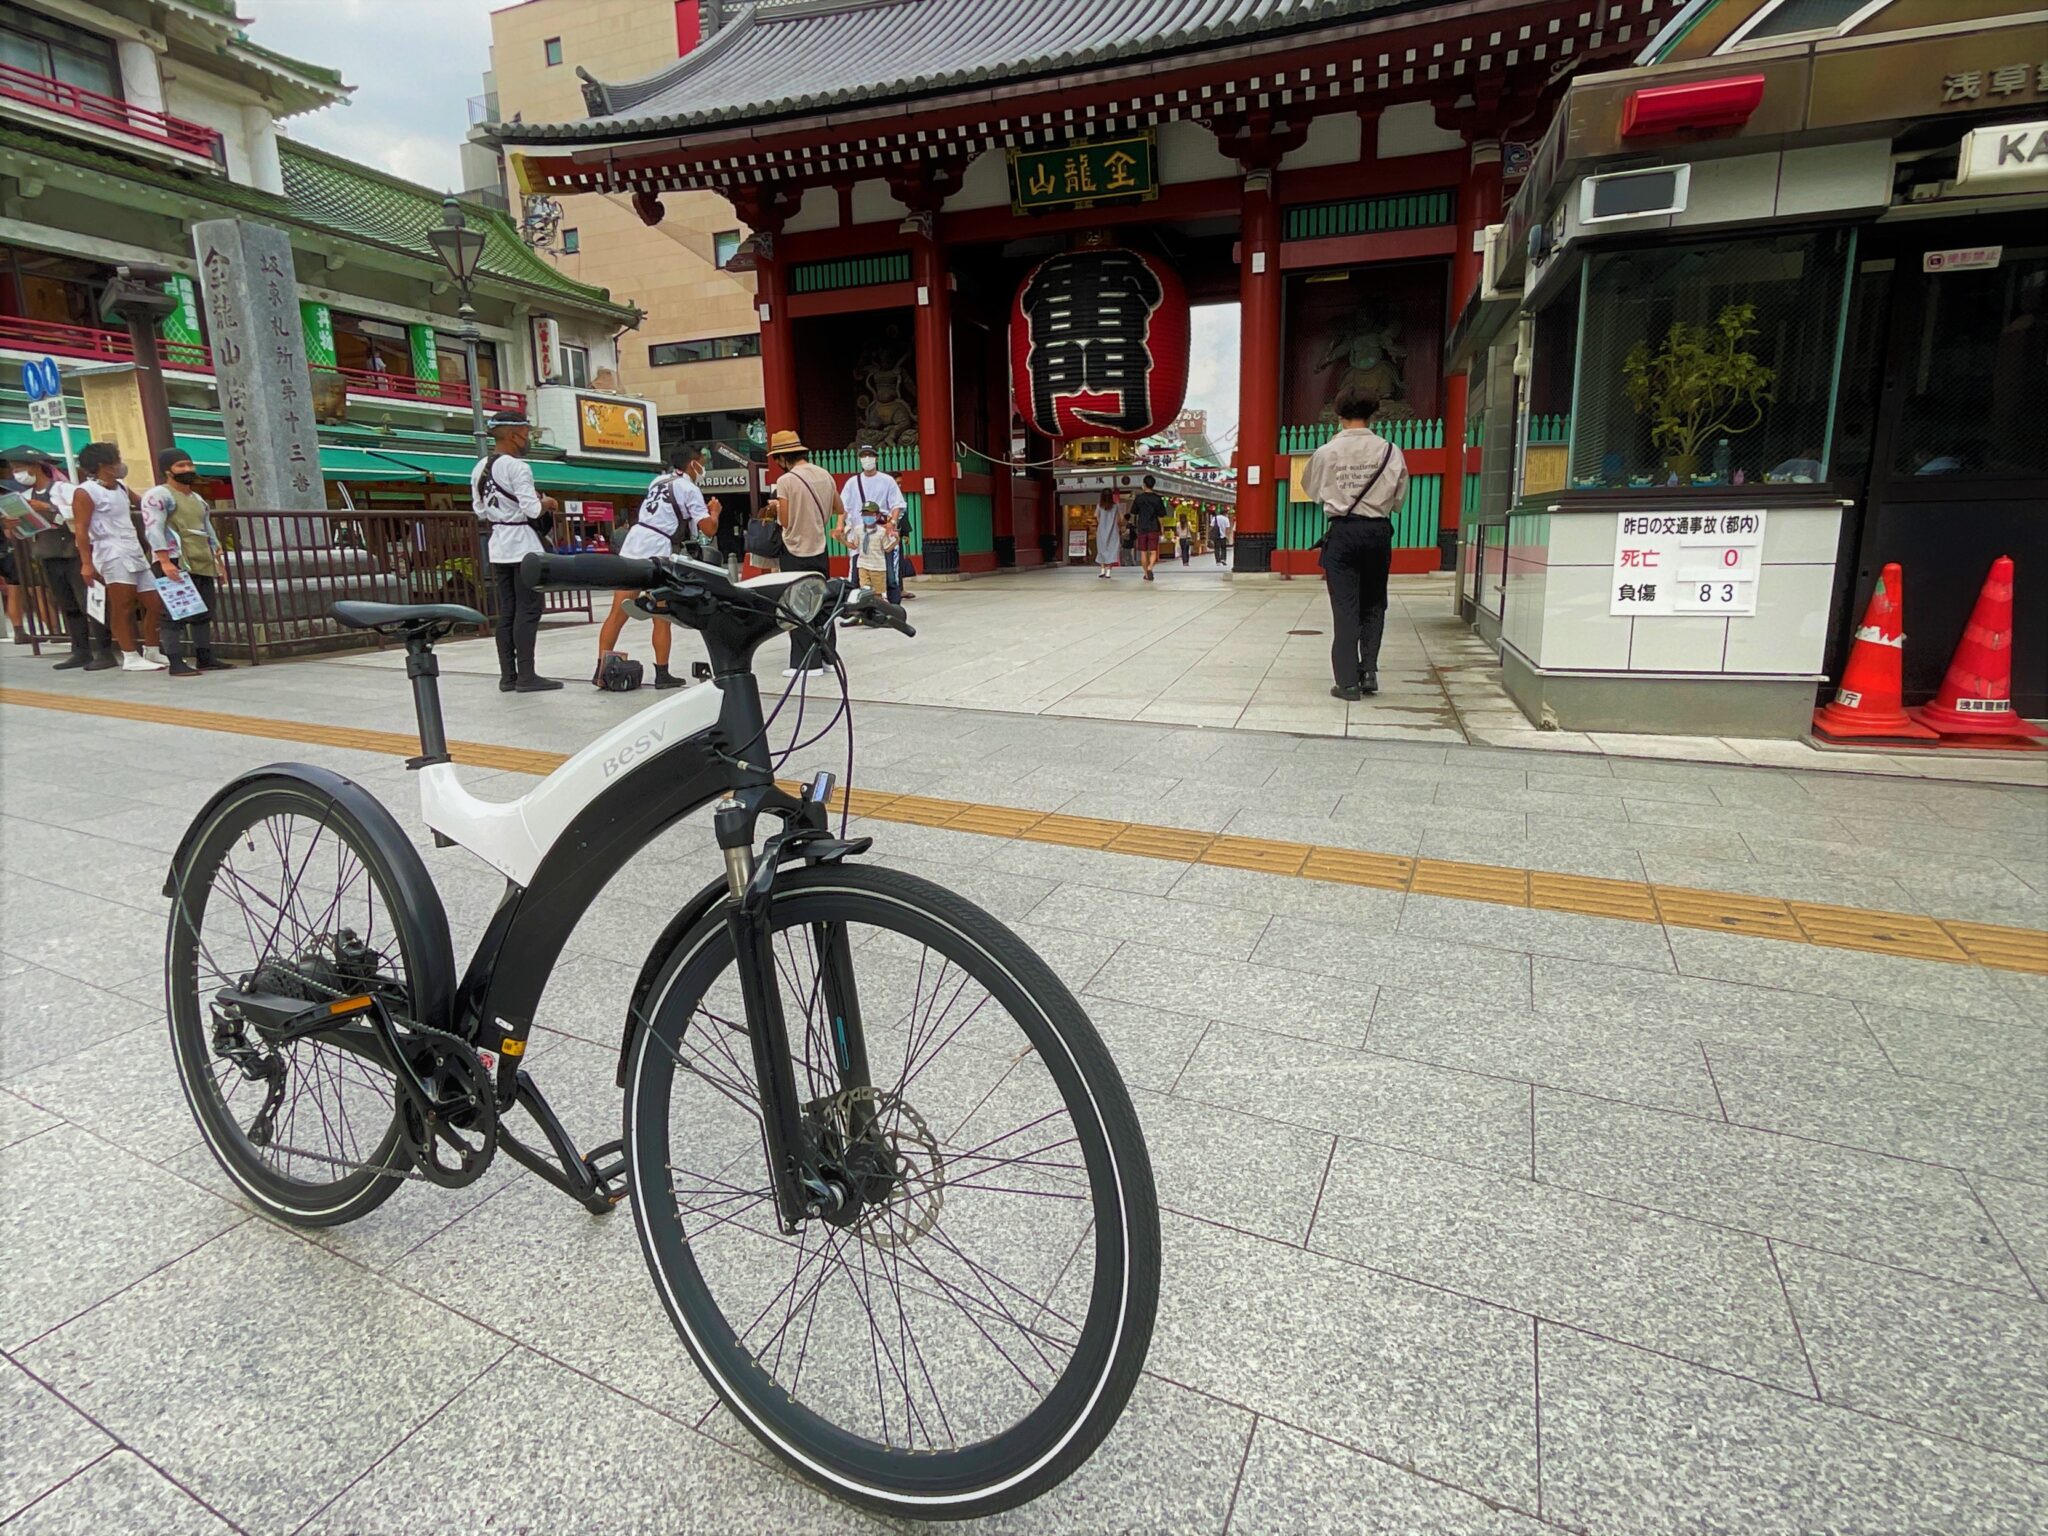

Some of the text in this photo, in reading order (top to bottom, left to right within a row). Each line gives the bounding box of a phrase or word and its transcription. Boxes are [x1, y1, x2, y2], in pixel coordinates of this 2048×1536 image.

[1620, 549, 1738, 567] 死亡 0
[1618, 583, 1657, 601] 負傷
